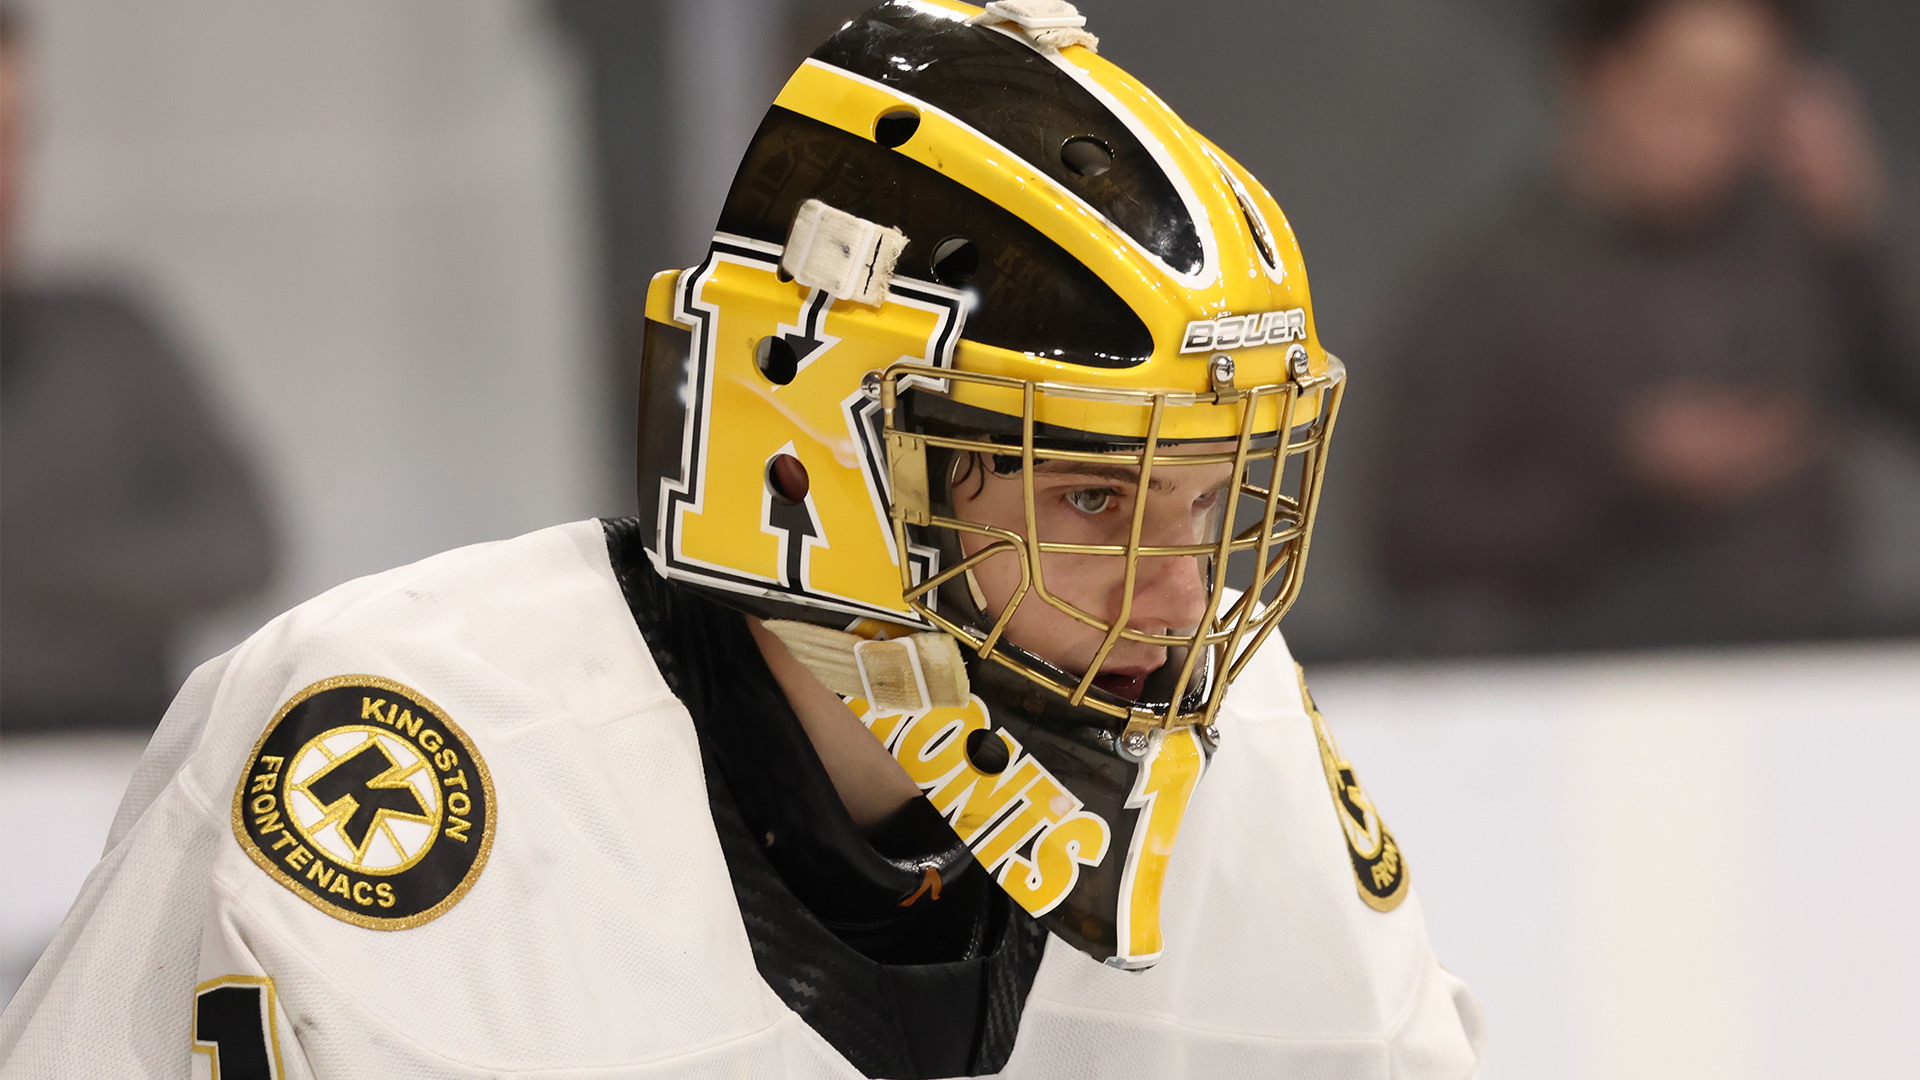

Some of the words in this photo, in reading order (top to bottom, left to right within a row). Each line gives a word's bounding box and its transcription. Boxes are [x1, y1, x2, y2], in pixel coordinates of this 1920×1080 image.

[1180, 308, 1307, 353] BAUER
[656, 232, 969, 631] K
[251, 754, 396, 908] FRONTENACS
[360, 696, 472, 843] KINGSTON
